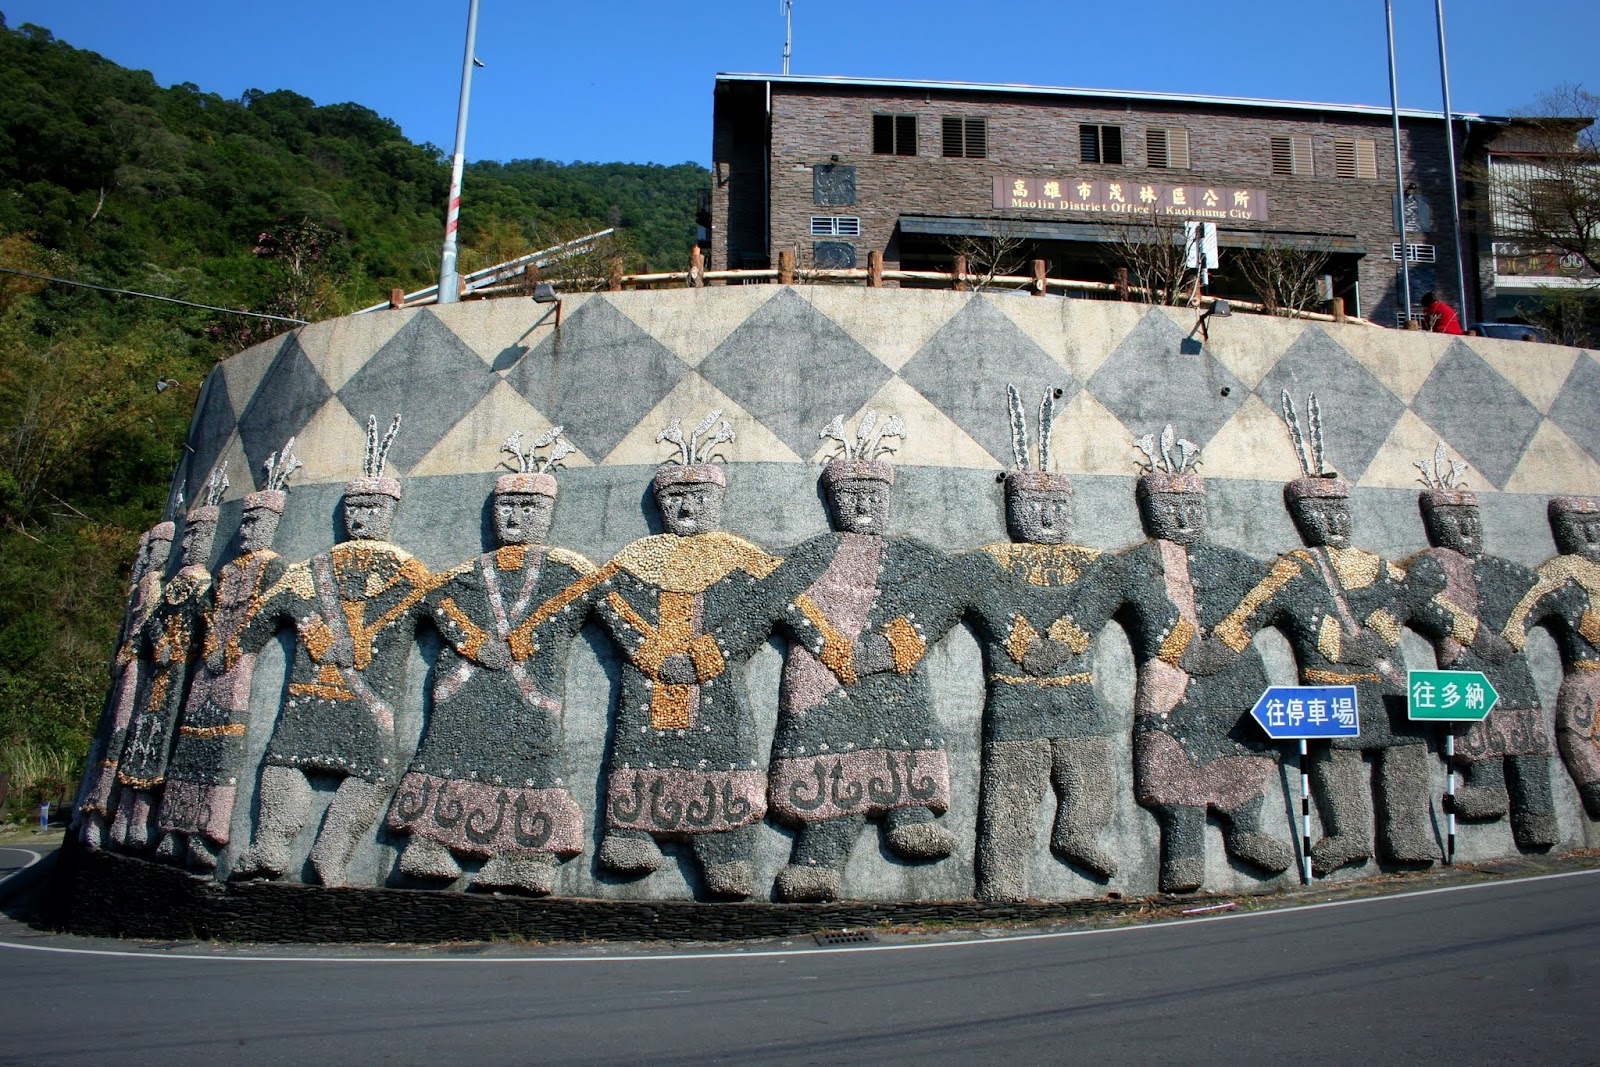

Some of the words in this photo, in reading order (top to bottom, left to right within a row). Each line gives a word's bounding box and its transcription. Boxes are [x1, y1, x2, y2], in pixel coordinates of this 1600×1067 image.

[1011, 198, 1055, 209] Maolin
[1060, 200, 1107, 212] District
[1165, 205, 1227, 218] Kaohsiung
[1229, 208, 1253, 219] City
[1012, 179, 1250, 209] 高雄市茂林區公所
[1412, 681, 1485, 710] 往多納
[1265, 698, 1355, 727] 往停車場
